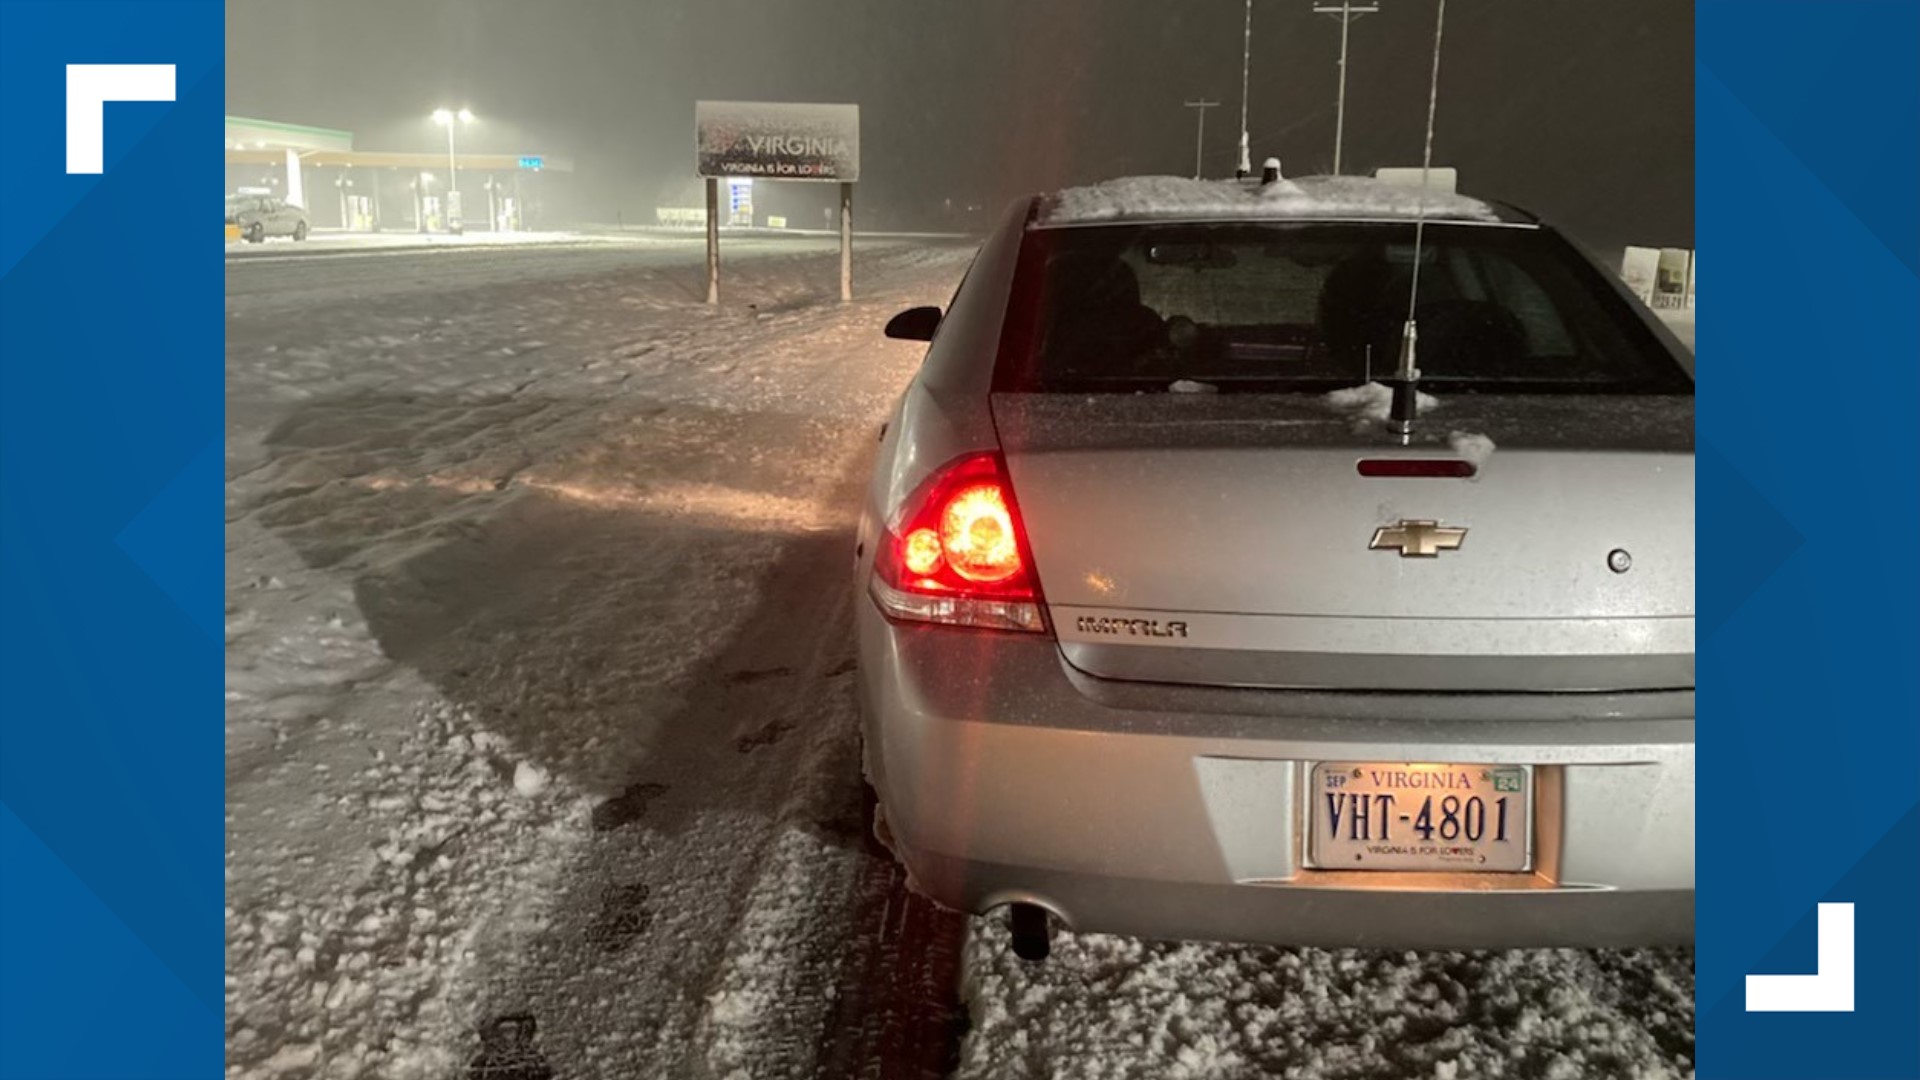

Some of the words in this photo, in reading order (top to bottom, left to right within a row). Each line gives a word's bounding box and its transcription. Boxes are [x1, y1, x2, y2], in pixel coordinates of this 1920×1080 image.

[746, 134, 850, 156] VIRGINIA
[720, 162, 765, 173] VIRGINIA
[766, 163, 775, 174] IS
[776, 162, 796, 174] FOR
[1078, 616, 1188, 637] IMPALA
[1326, 775, 1346, 787] SEP
[1371, 771, 1472, 789] VIRGINIA
[1325, 793, 1508, 842] VHT-4801
[1367, 845, 1408, 855] VIRGINIA
[1409, 846, 1417, 855] IS
[1419, 846, 1438, 855] FOR
